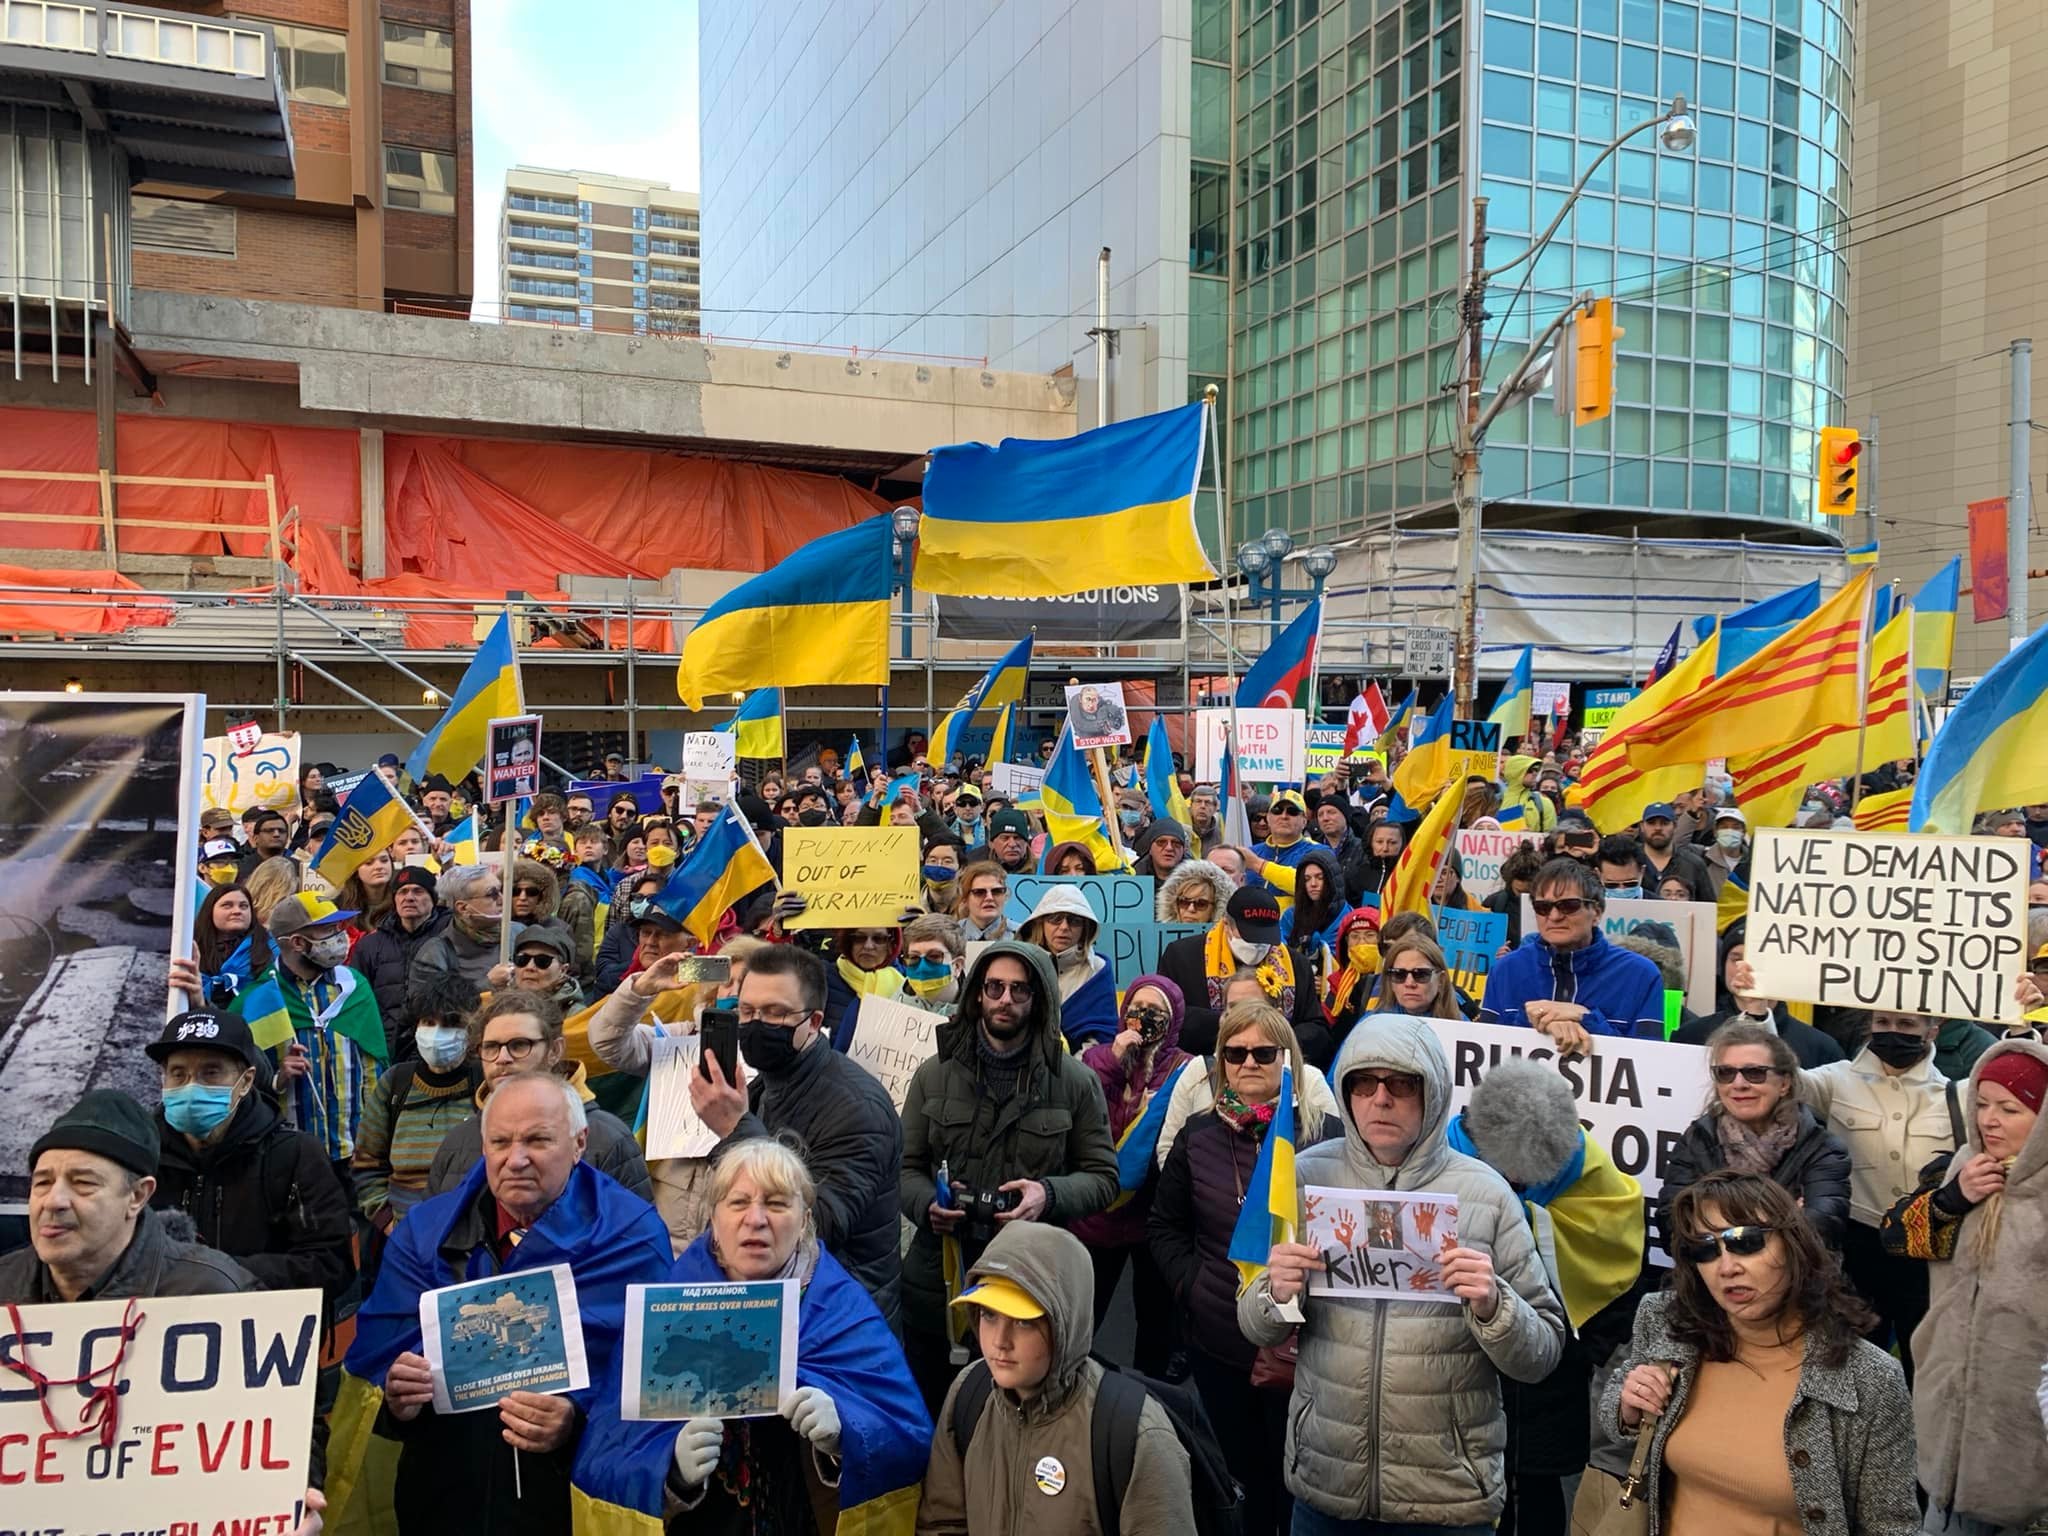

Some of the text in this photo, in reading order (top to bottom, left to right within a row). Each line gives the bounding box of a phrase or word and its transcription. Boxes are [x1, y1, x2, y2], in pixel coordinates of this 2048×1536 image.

[1407, 629, 1448, 641] PEDESTRIANS
[1411, 640, 1445, 652] CROSS AT
[1410, 651, 1445, 663] WEST SIDE
[1407, 662, 1425, 673] ONLY
[1595, 692, 1632, 705] STAND
[1079, 735, 1122, 746] STOP WAR
[1217, 723, 1279, 743] UITED
[1237, 742, 1268, 756] WITH
[493, 764, 536, 780] WANTED
[1219, 755, 1286, 772] RAINE
[327, 777, 345, 789] STOP
[795, 832, 904, 858] PUTIN!!
[1461, 857, 1500, 881] Clos
[1774, 838, 2019, 883] WE DEMAND
[796, 864, 867, 883] OUT OF
[1244, 906, 1281, 920] CANAD
[1754, 882, 2014, 928] NATO USE ITS
[1438, 915, 1493, 944] PEOPLE
[1758, 923, 2023, 972] ARMY TO STOP
[1819, 962, 2004, 1020] PUTIN!
[1454, 1040, 1643, 1109] RSIA
[1323, 1245, 1413, 1291] Killer
[682, 1287, 700, 1298] НАД
[650, 1298, 778, 1313] CLOSE THE SKIES OVER UKRAINE
[453, 1383, 476, 1394] CLOSE
[477, 1379, 492, 1389] THE
[492, 1373, 513, 1385] SKIES
[513, 1368, 532, 1379] OVER
[455, 1370, 568, 1402] THE WHOLE WORLD IS IN DANGER
[86, 1440, 142, 1480] OF
[132, 1425, 153, 1435] THE
[150, 1417, 290, 1476] EVIL
